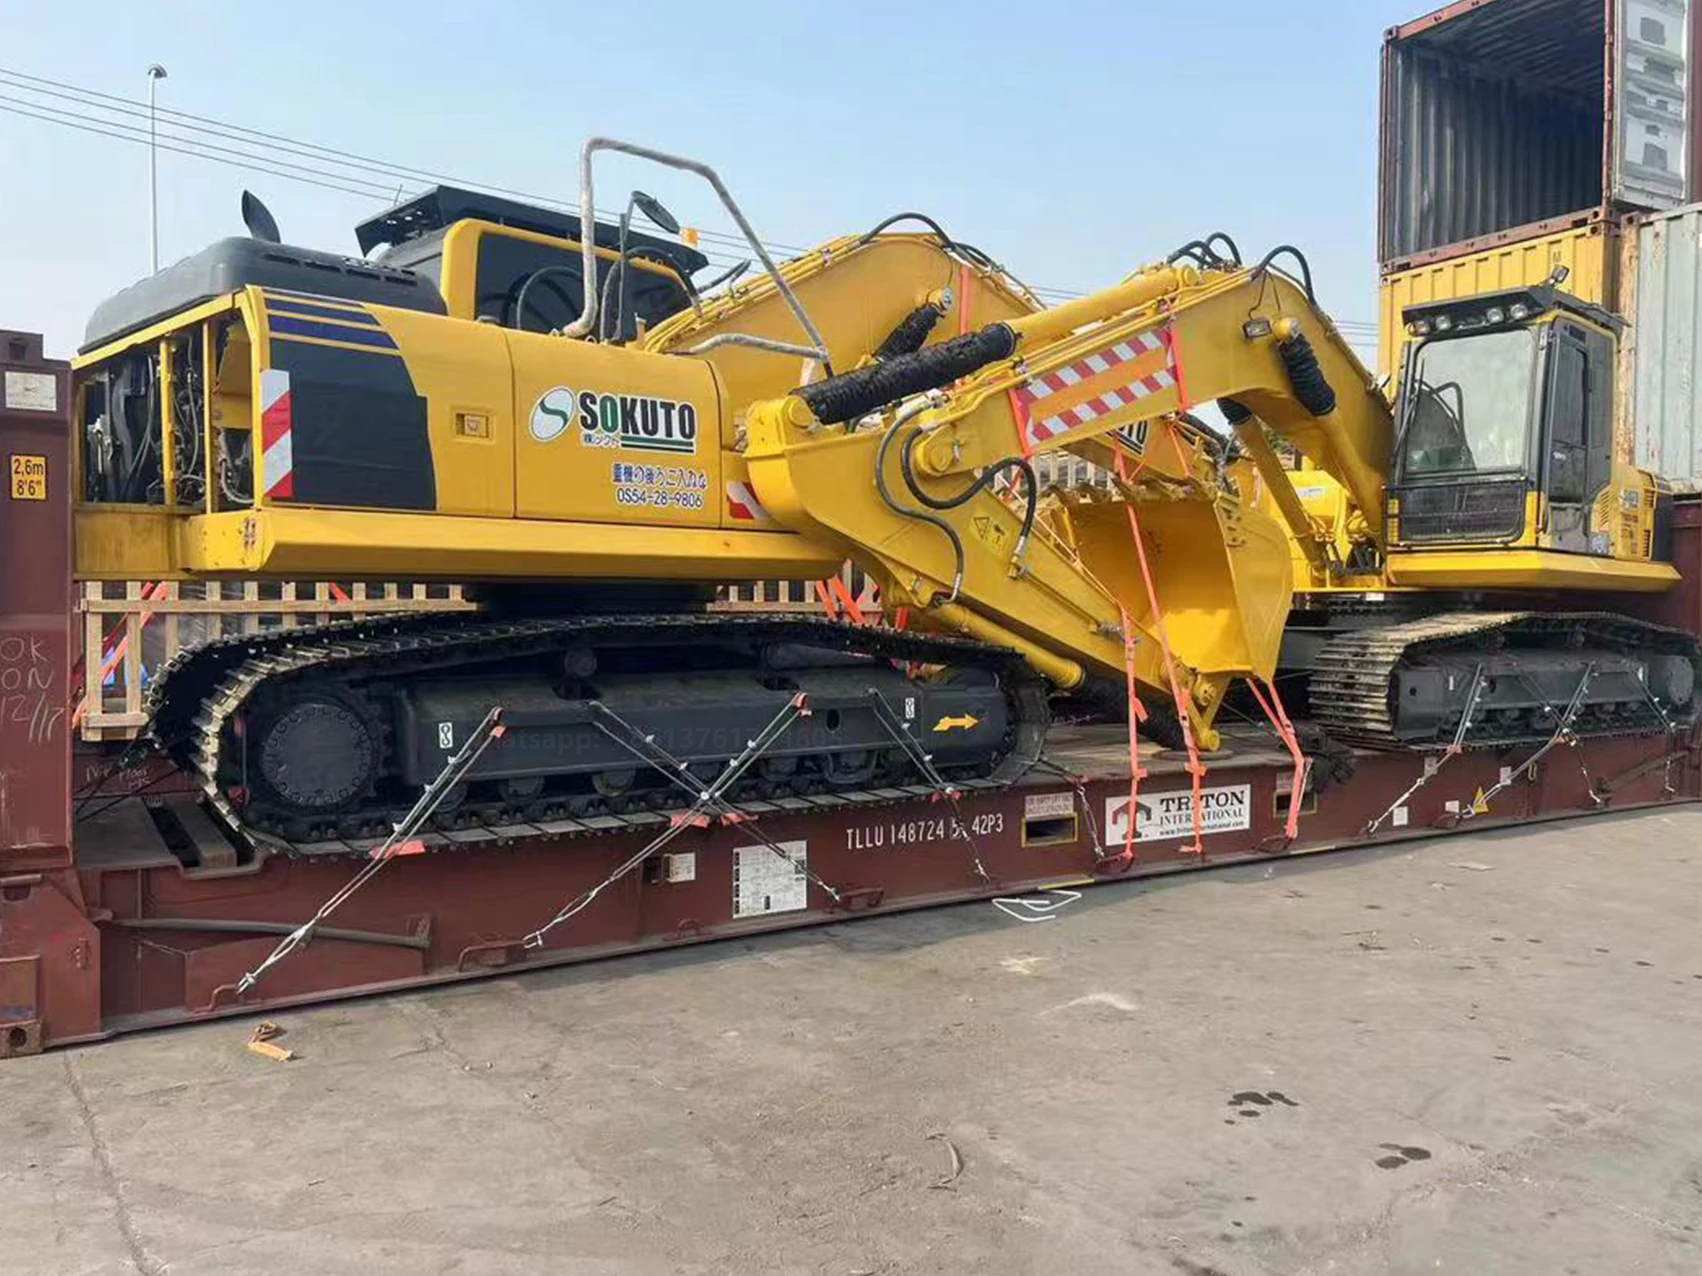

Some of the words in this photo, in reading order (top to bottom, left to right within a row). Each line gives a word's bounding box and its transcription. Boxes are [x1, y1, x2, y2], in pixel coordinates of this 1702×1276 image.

[579, 392, 696, 440] SOKUTO
[0, 636, 48, 665] OK
[1160, 790, 1245, 813] TRTON
[846, 826, 884, 850] TLLU
[891, 818, 945, 844] 148724
[971, 813, 1004, 835] 42P3
[1160, 808, 1244, 826] INTERATIONAL
